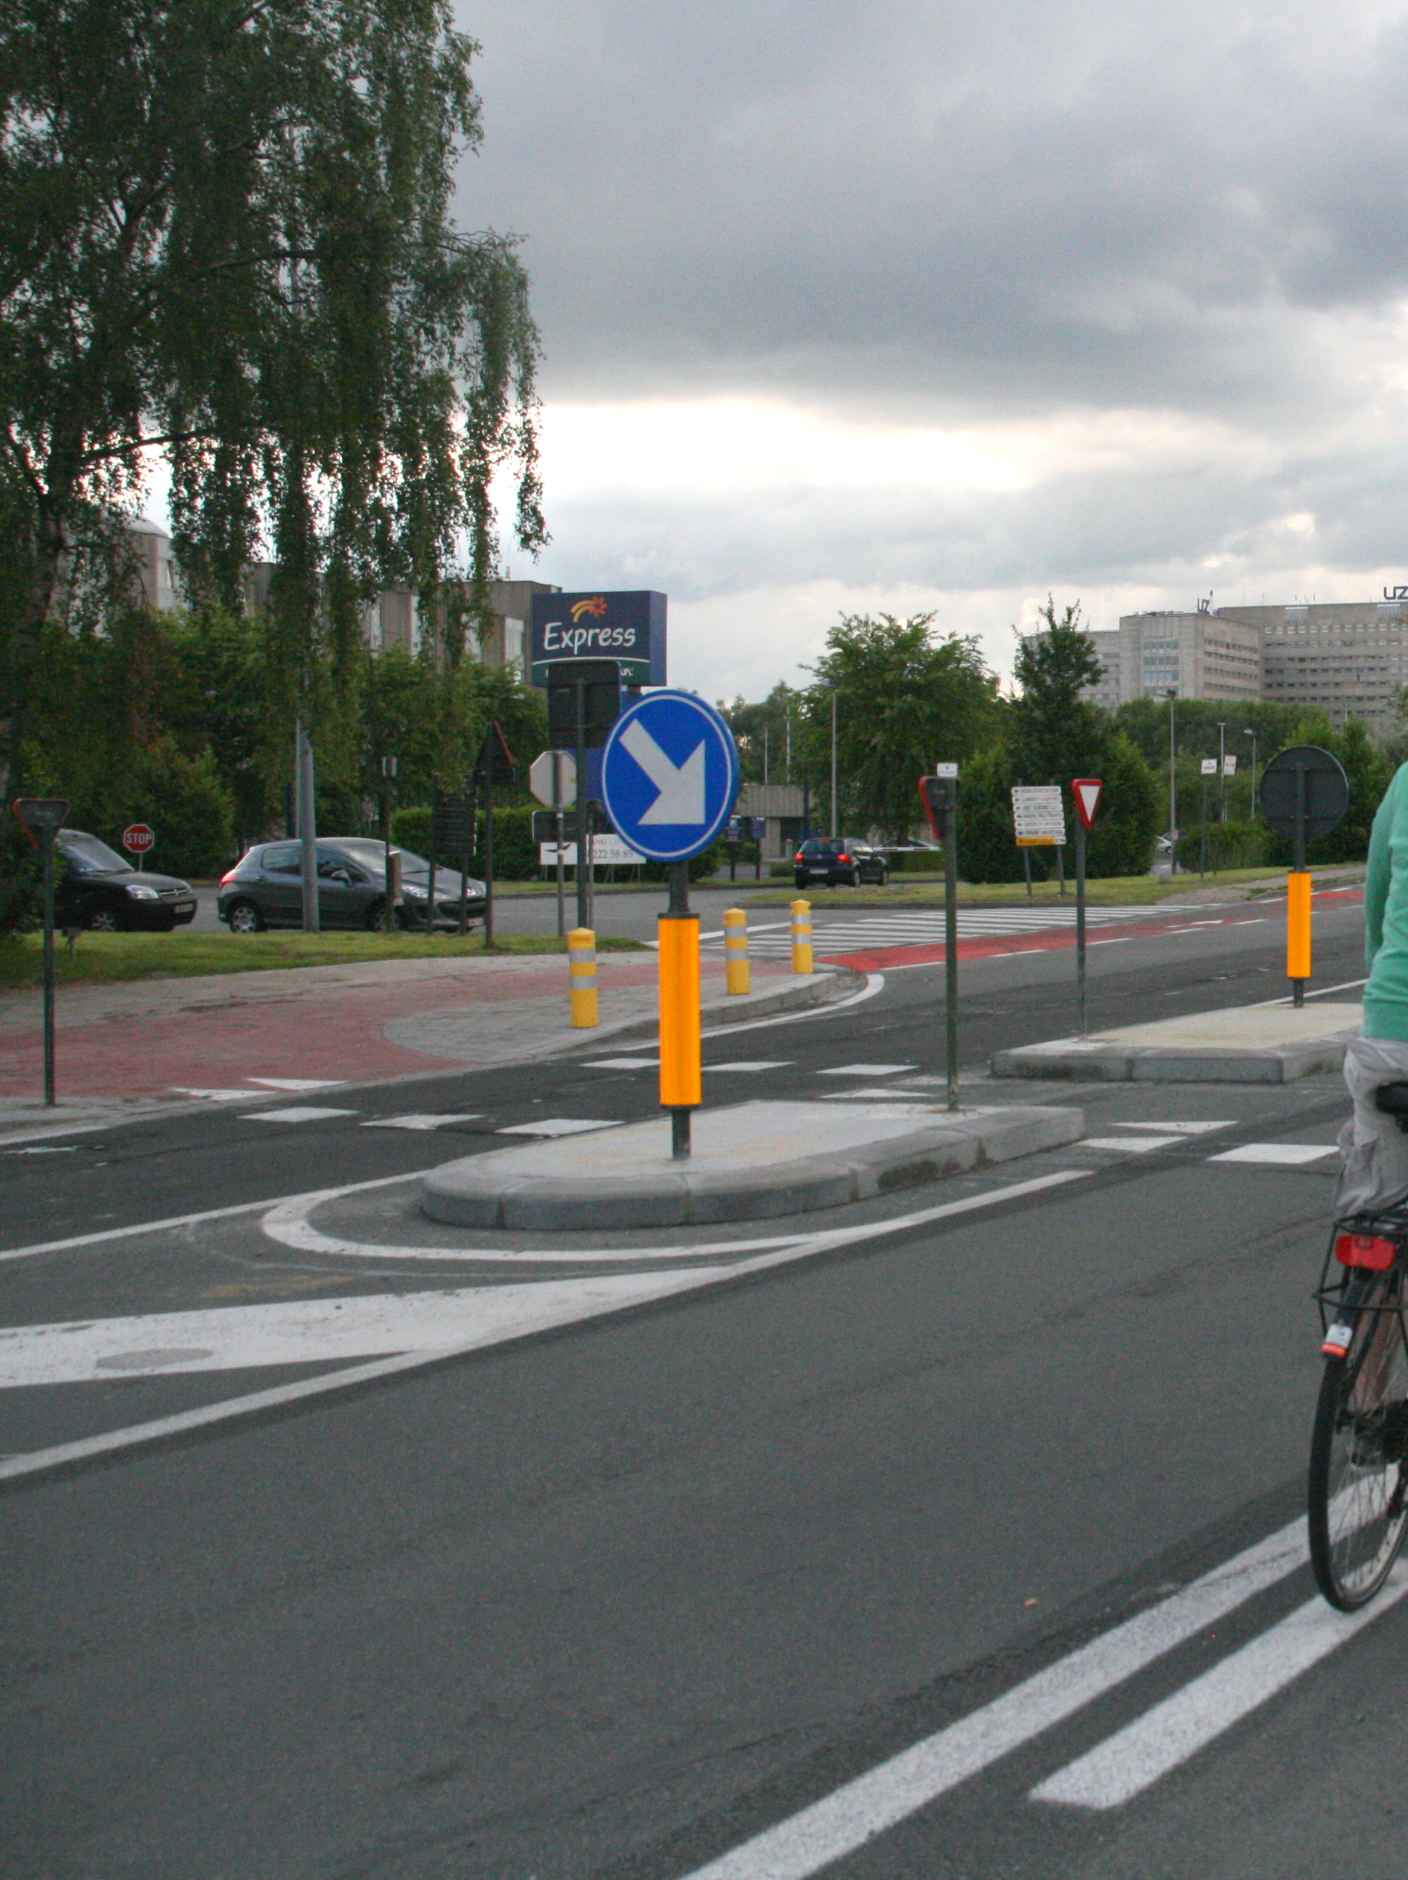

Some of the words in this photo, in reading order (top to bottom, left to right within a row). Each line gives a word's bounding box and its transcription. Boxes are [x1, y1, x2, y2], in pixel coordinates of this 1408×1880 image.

[1383, 585, 1408, 600] UZ
[543, 621, 636, 655] Express
[126, 832, 153, 845] STOP
